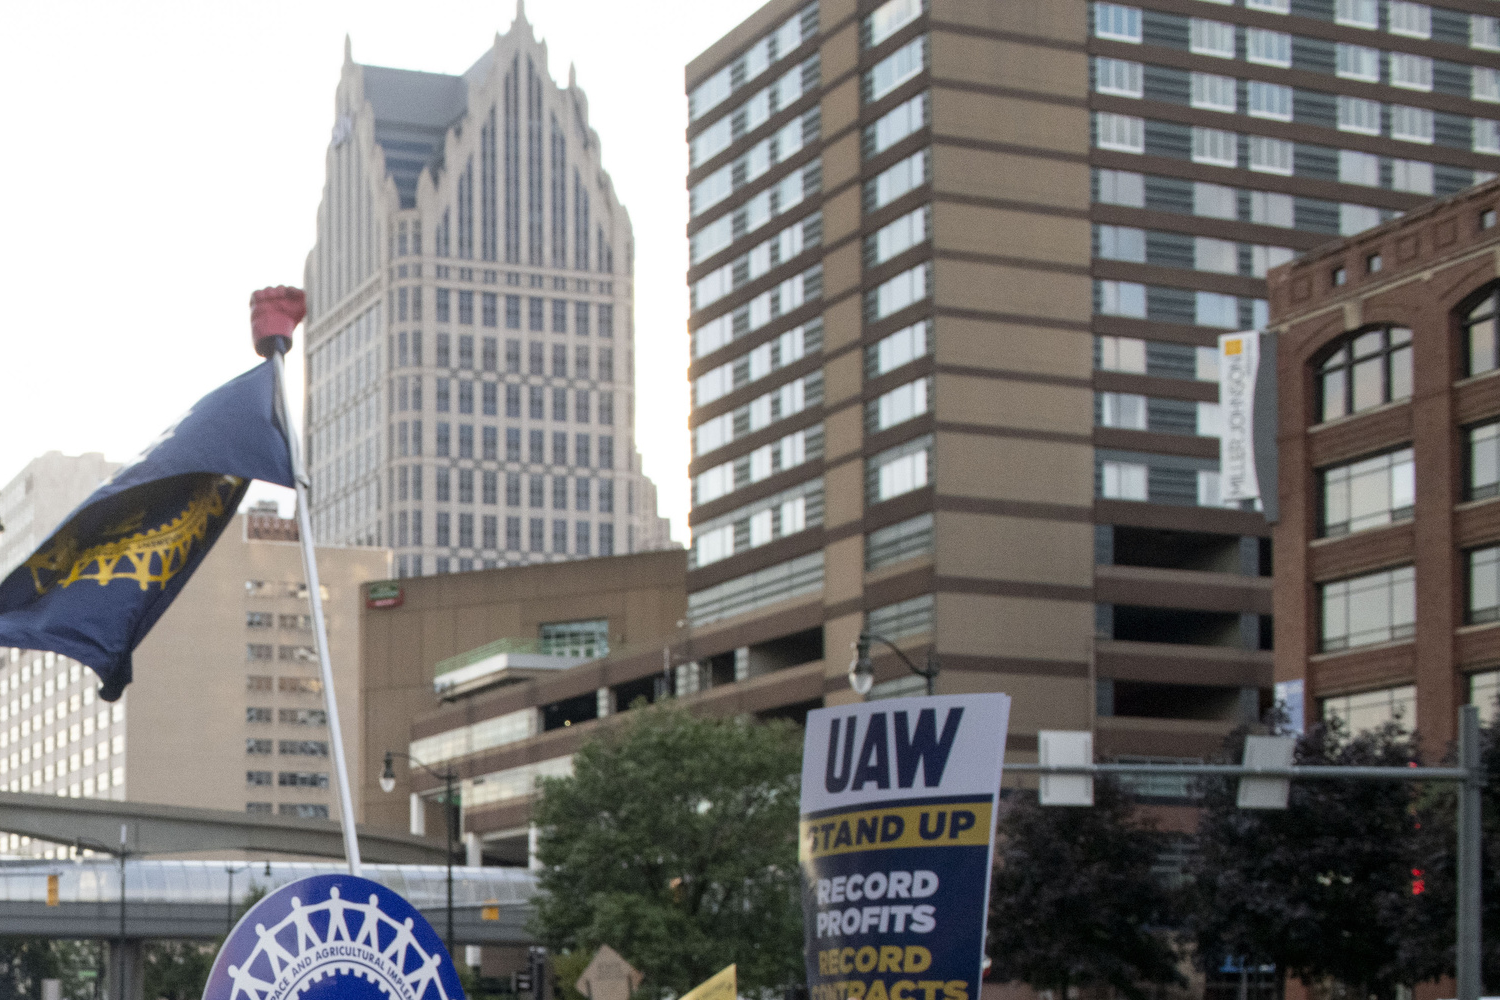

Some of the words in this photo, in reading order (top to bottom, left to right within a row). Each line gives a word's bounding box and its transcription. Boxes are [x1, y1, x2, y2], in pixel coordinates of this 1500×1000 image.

[825, 706, 965, 794] UAW
[919, 810, 976, 841] UP
[816, 869, 939, 906] RECORD
[816, 904, 937, 939] PROFITS
[291, 956, 313, 978] AND
[314, 945, 386, 972] AGRICULTURAL
[818, 945, 933, 976] RECORD
